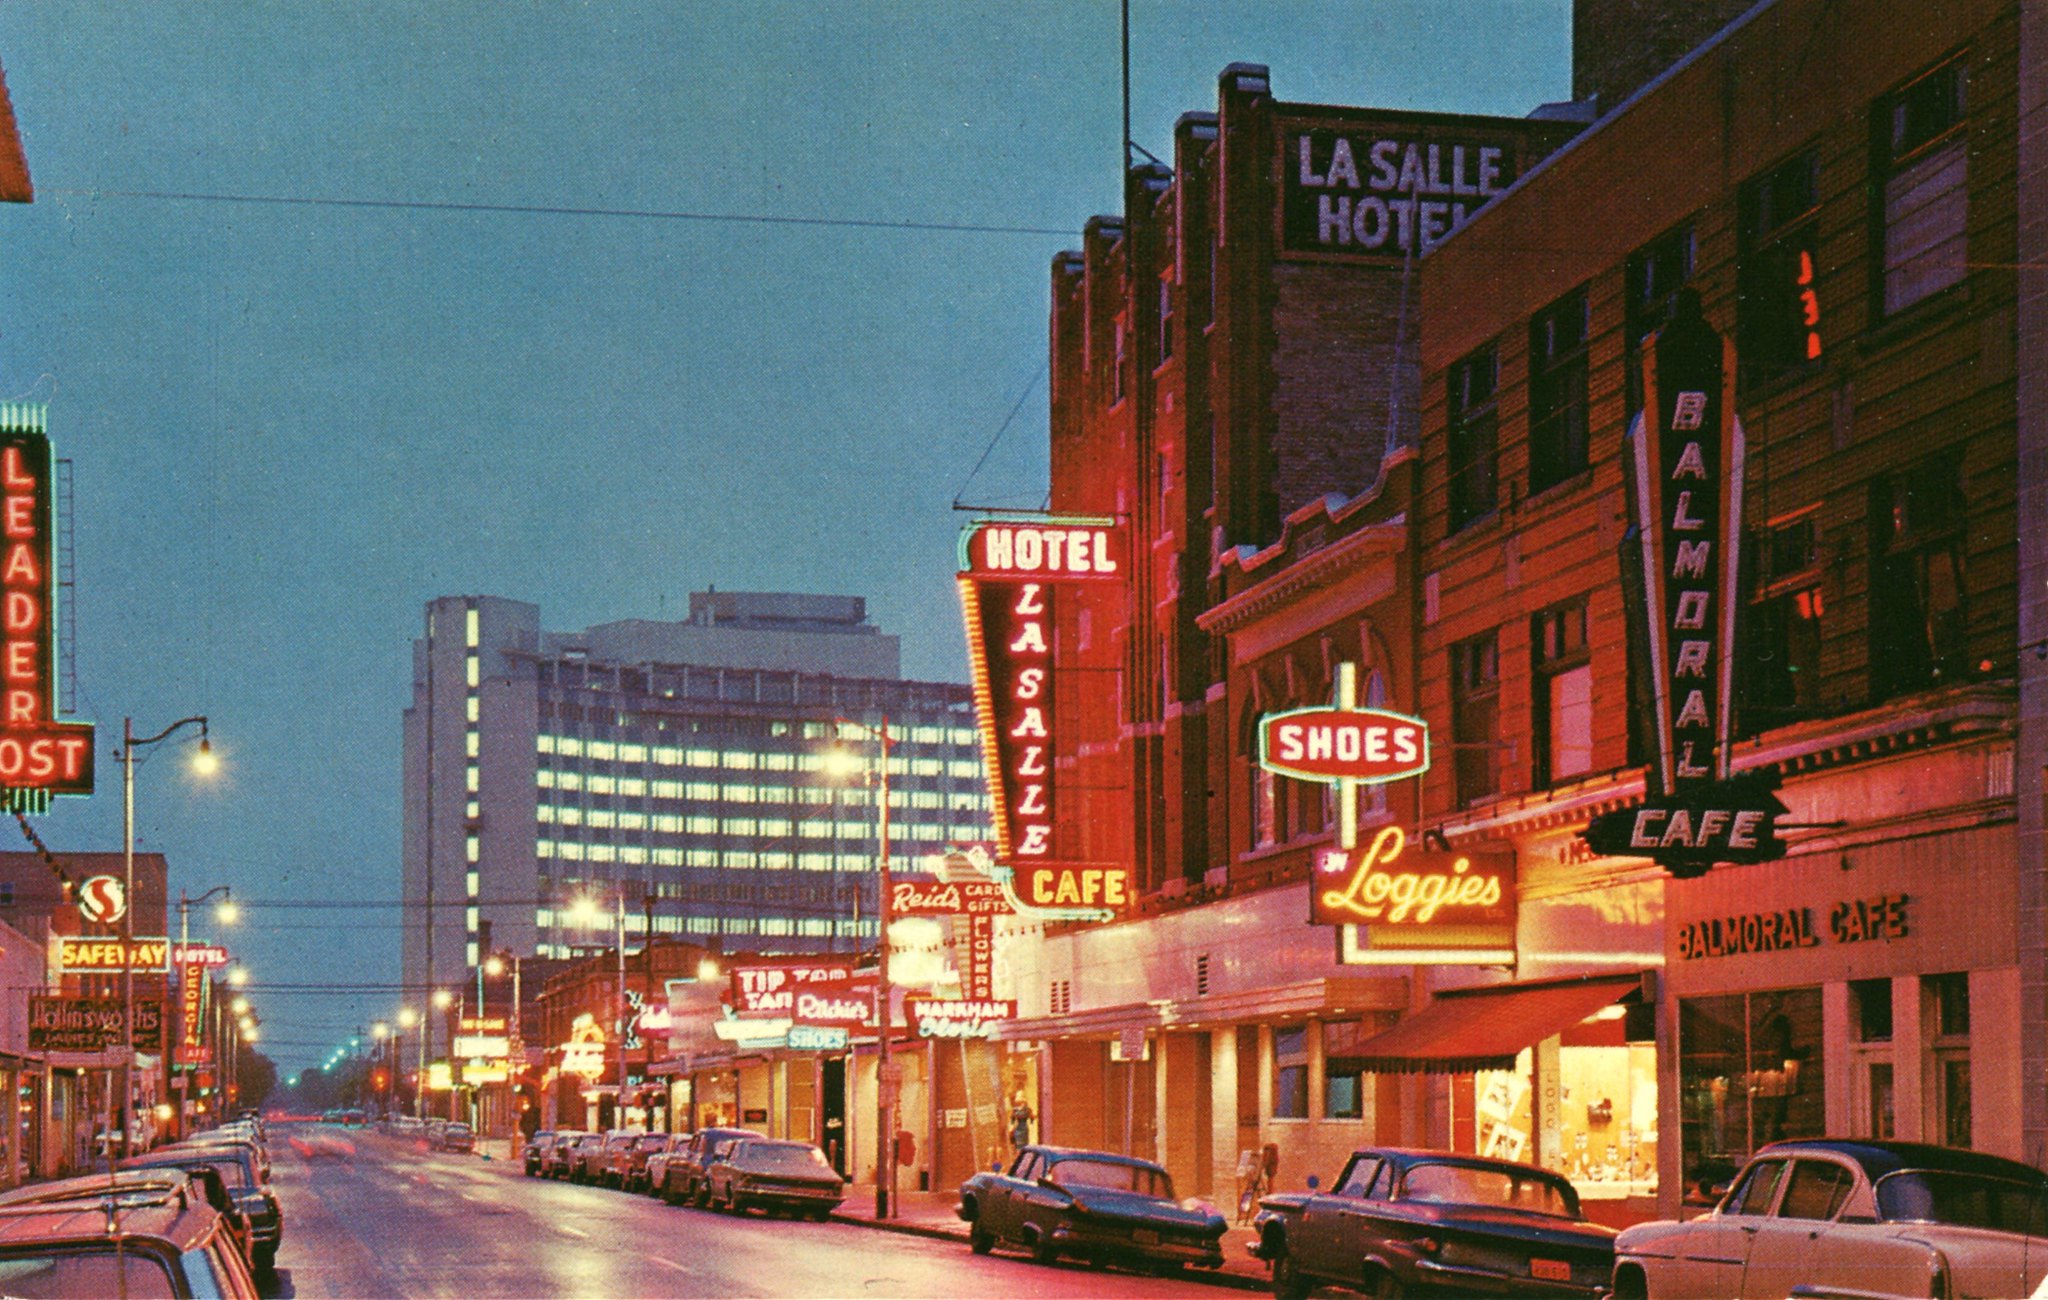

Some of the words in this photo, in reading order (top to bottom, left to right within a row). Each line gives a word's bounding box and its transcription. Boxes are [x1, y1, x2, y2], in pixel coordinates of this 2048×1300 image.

[1299, 136, 1360, 189] LA
[1369, 140, 1506, 196] SALLE
[986, 528, 1117, 572] HOTEL
[6, 447, 37, 723] LEADER
[1672, 391, 1710, 778] BALMORAL
[1010, 584, 1047, 653] LA
[0, 738, 83, 778] OST
[1011, 668, 1050, 855] SALLE
[1279, 725, 1417, 763] SHOES
[1630, 810, 1765, 848] CAFE
[892, 883, 961, 911] Reid's
[1033, 869, 1126, 905] CAFE
[1322, 827, 1501, 923] Loggies
[968, 900, 1009, 912] GIFTS
[1677, 907, 1820, 960] BALMORAL
[1828, 892, 1910, 944] CAFE
[738, 970, 785, 993] TIP
[974, 916, 989, 999] FLOWERS
